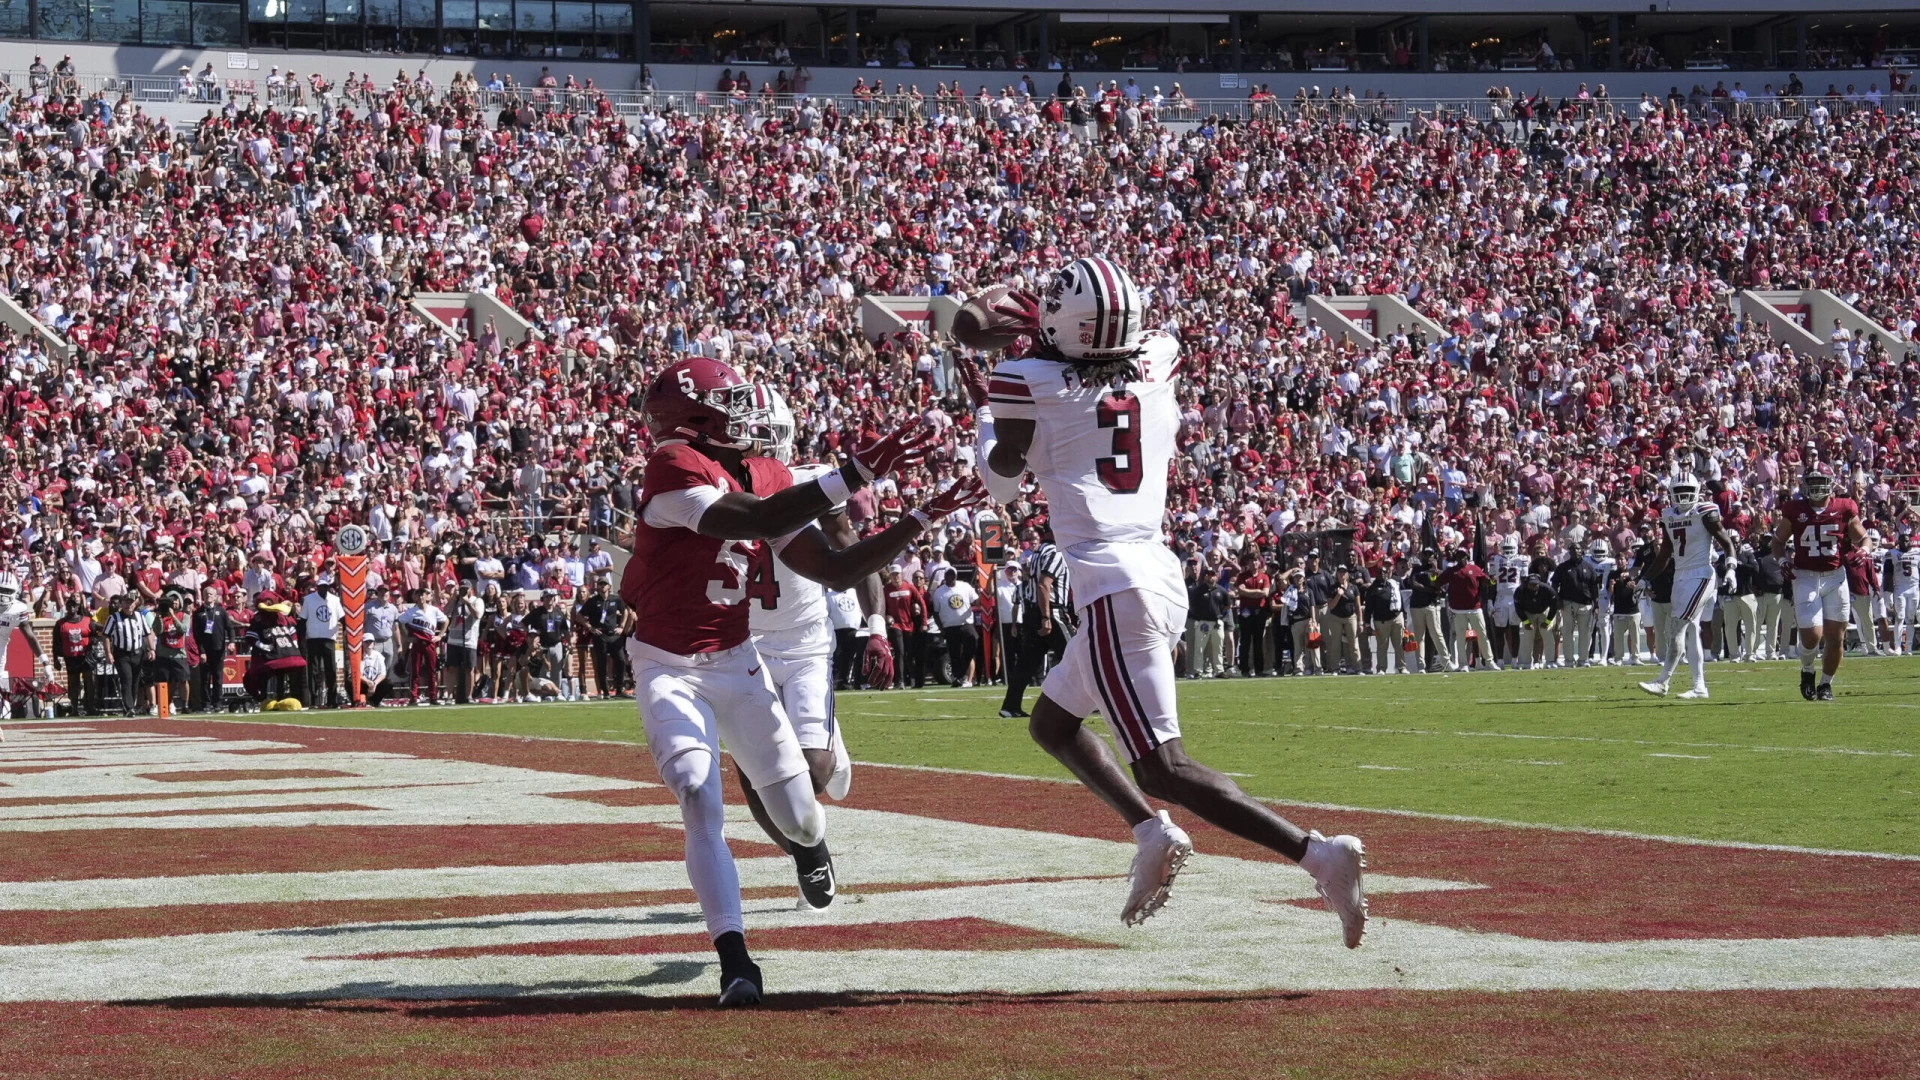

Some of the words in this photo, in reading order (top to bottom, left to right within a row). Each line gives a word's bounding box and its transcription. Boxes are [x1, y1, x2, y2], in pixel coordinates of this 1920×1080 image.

[1080, 332, 1093, 345] SEC
[677, 368, 695, 394] 5
[1528, 370, 1539, 382] 18
[1095, 389, 1143, 494] 3
[341, 529, 361, 550] SEC
[985, 524, 1002, 548] 2
[1672, 527, 1687, 557] 7
[1800, 524, 1839, 557] 45
[705, 539, 755, 606] 5
[748, 540, 781, 610] 4
[1498, 566, 1518, 584] 22
[1903, 561, 1912, 577] 5
[316, 605, 332, 622] SEC
